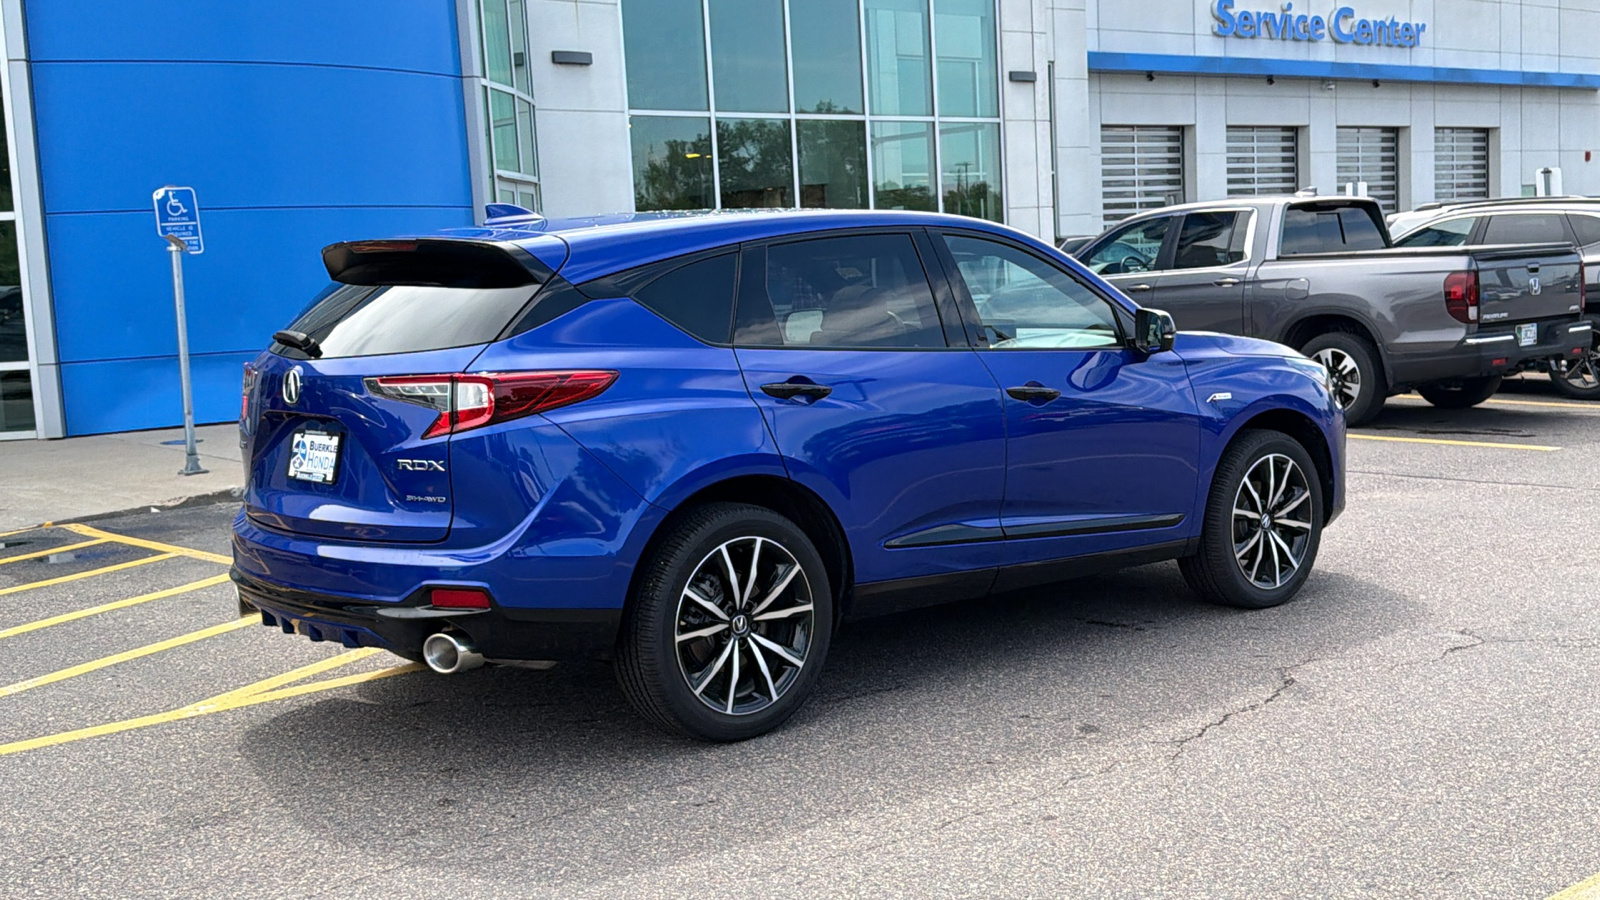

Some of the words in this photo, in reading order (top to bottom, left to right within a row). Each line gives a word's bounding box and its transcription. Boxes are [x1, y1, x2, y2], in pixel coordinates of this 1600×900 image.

[1213, 0, 1325, 40] Service
[1331, 7, 1426, 46] Center
[309, 440, 338, 453] BUERKLE
[306, 451, 335, 471] HONDA
[397, 459, 446, 471] RDX
